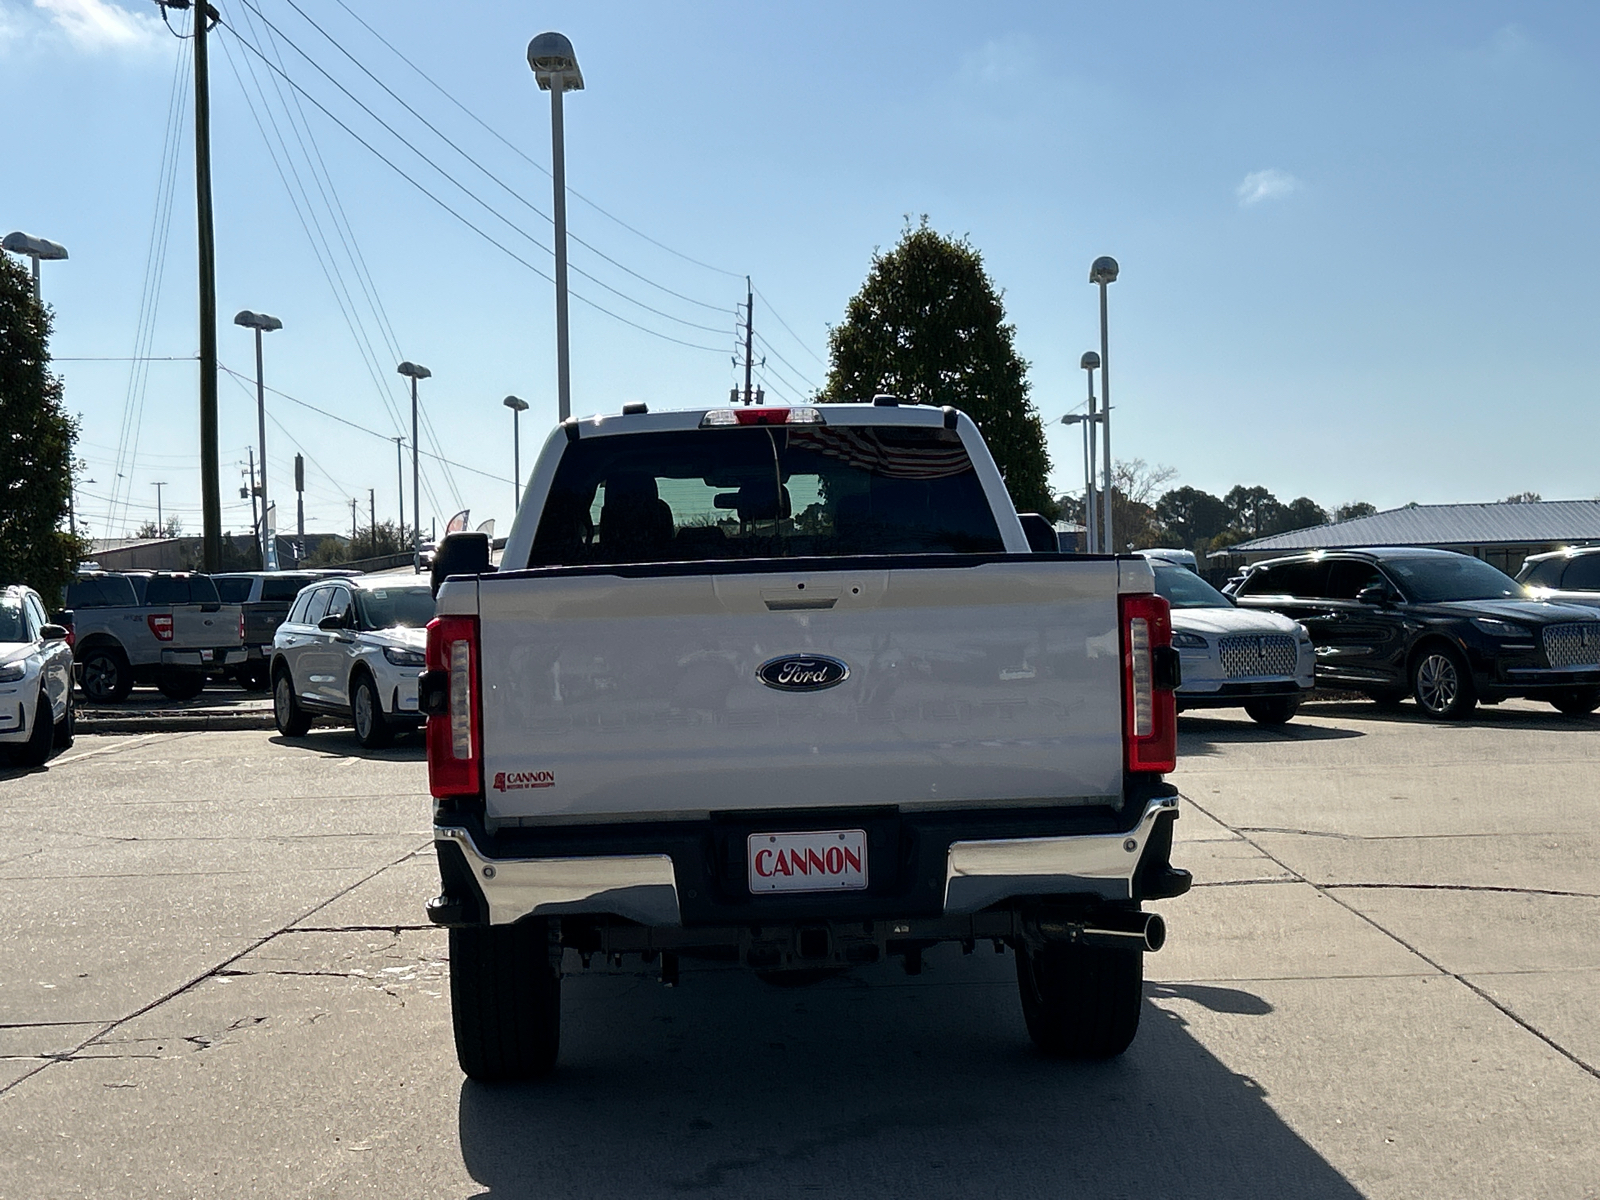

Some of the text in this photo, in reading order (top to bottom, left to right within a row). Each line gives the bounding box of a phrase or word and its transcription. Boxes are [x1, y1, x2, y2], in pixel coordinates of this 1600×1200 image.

[778, 661, 828, 683] Ford
[507, 771, 555, 783] CANNON
[755, 846, 861, 877] CANNON
